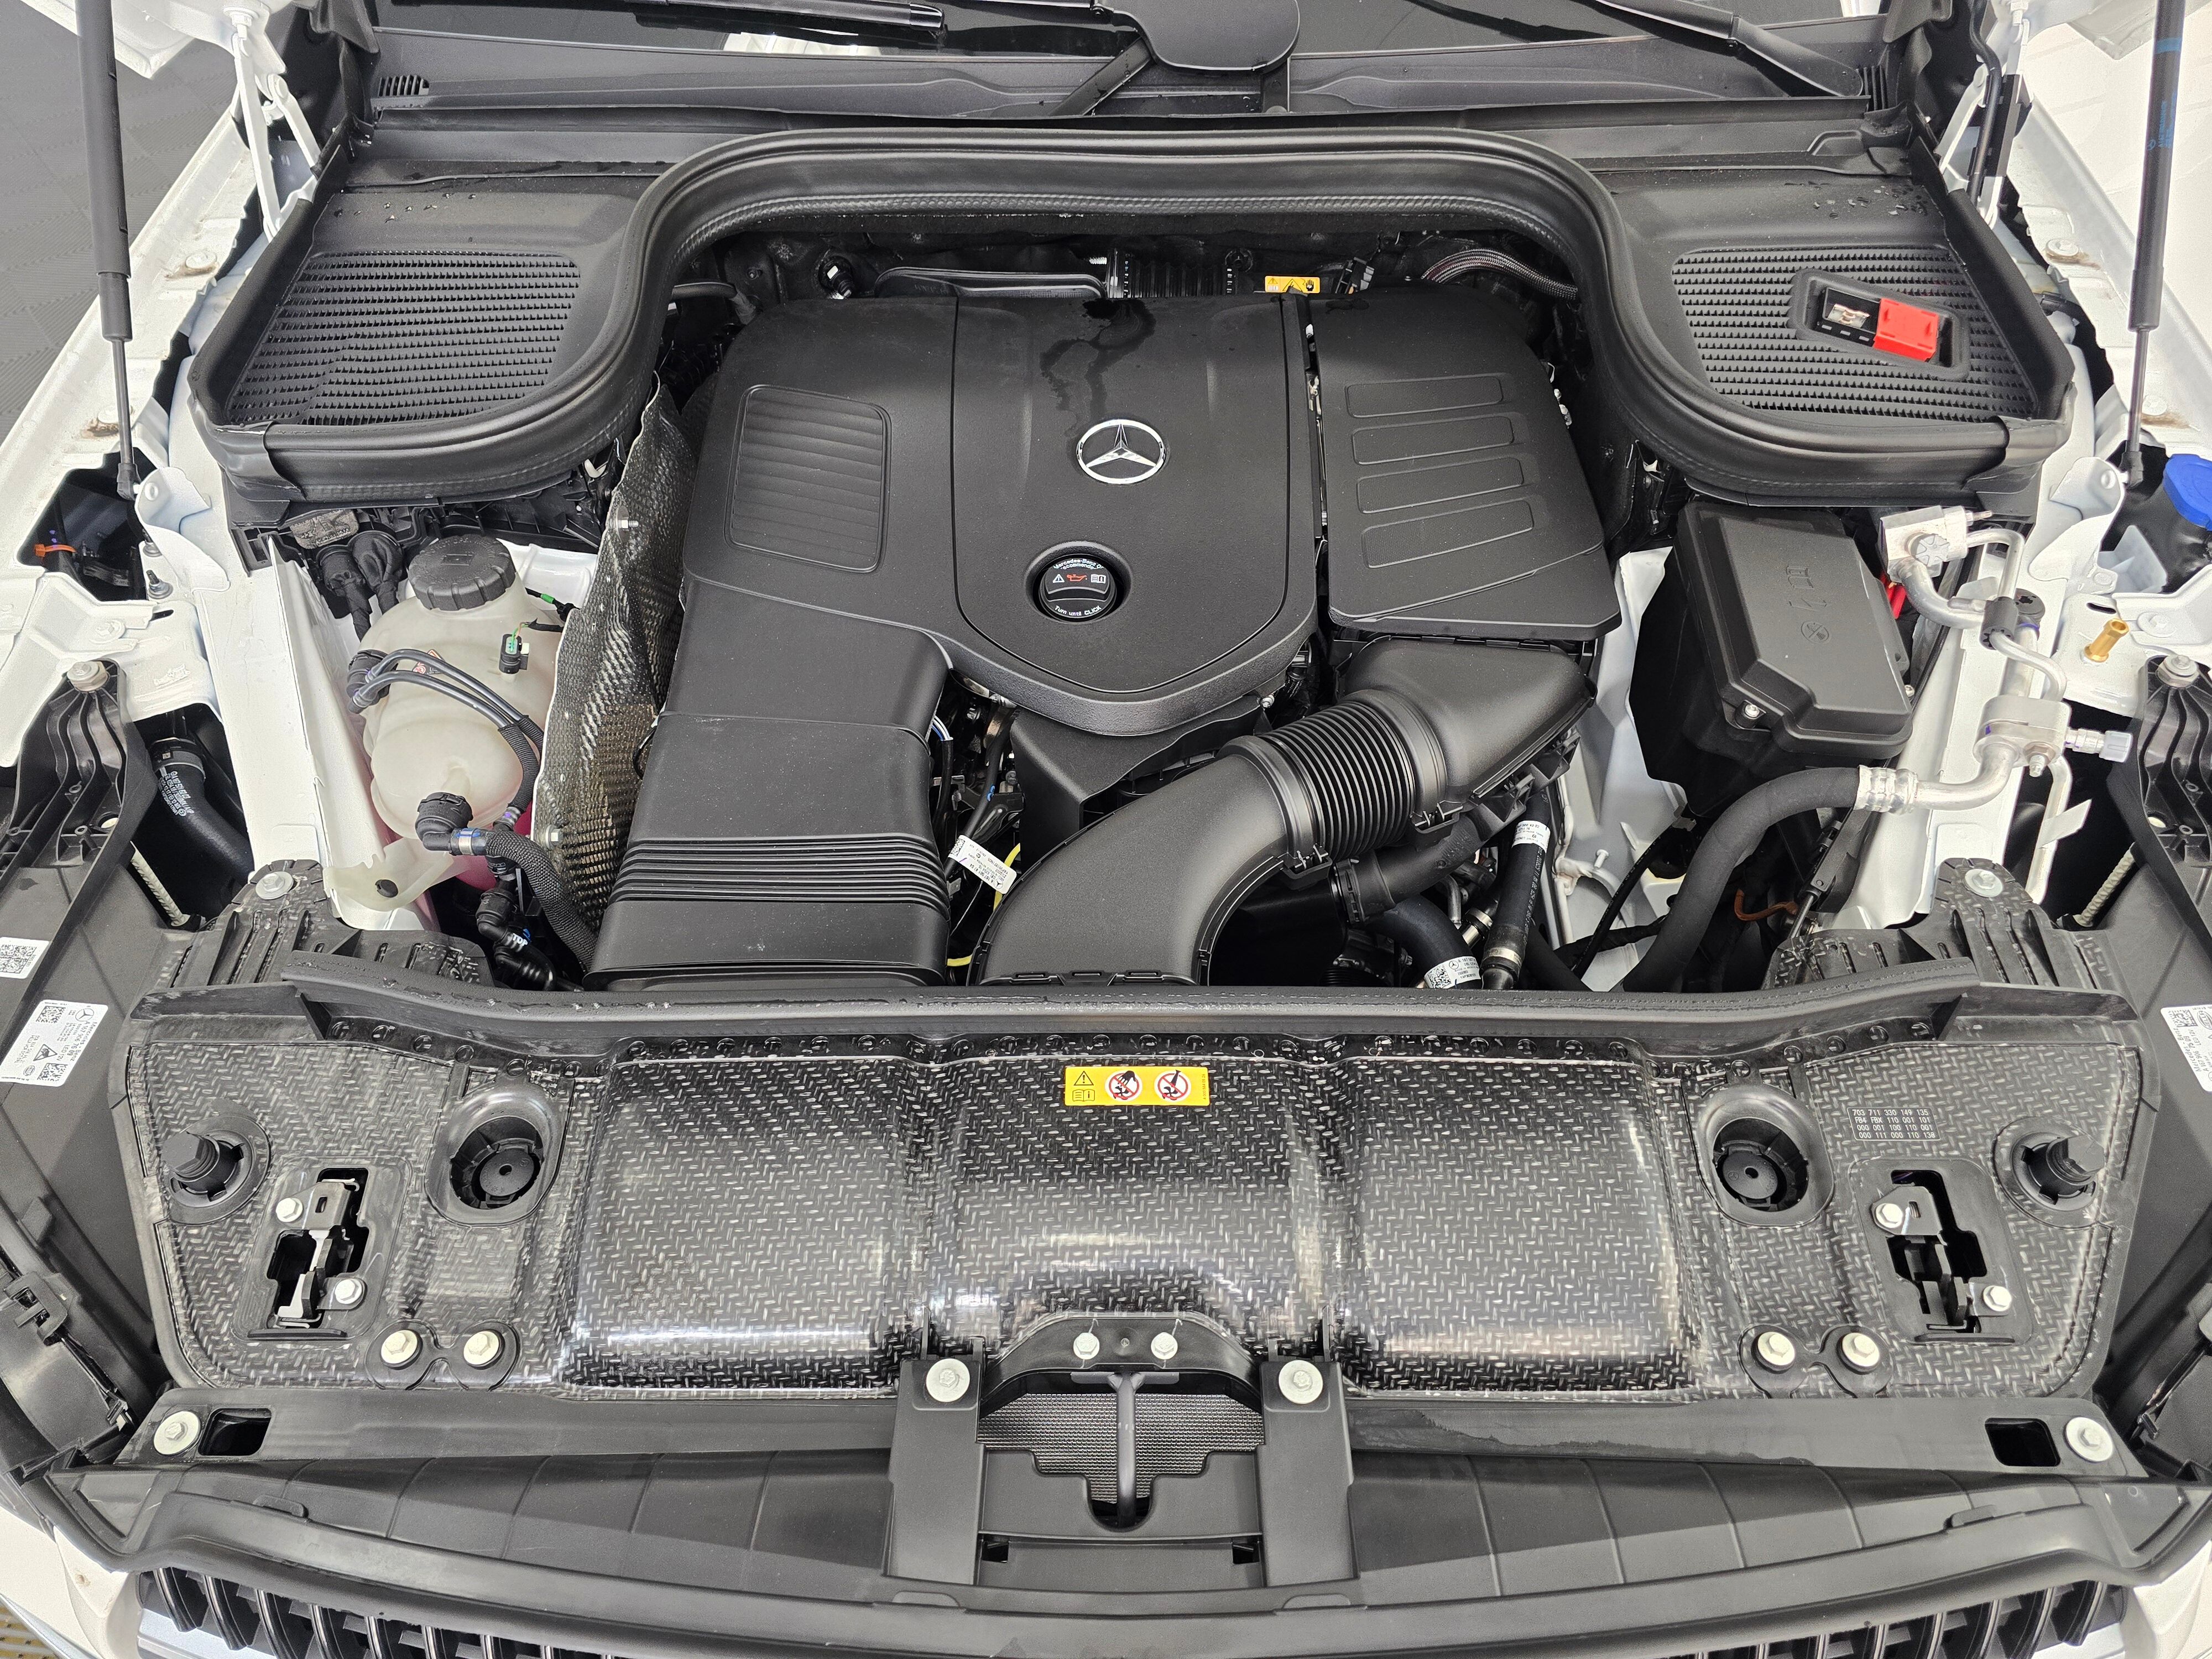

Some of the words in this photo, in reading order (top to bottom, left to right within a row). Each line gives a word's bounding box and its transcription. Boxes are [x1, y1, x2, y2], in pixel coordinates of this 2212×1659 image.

[1055, 605, 1067, 614] Turn
[1084, 605, 1102, 615] CLICK
[512, 932, 528, 946] TOP
[2198, 1010, 2211, 1027] HELLA
[79, 1021, 98, 1045] Mercedes
[2173, 1028, 2184, 1040] Benz
[2193, 1037, 2201, 1045] LED
[60, 1045, 70, 1053] LED
[69, 1050, 81, 1061] Benz
[2183, 1046, 2201, 1072] Mercedes
